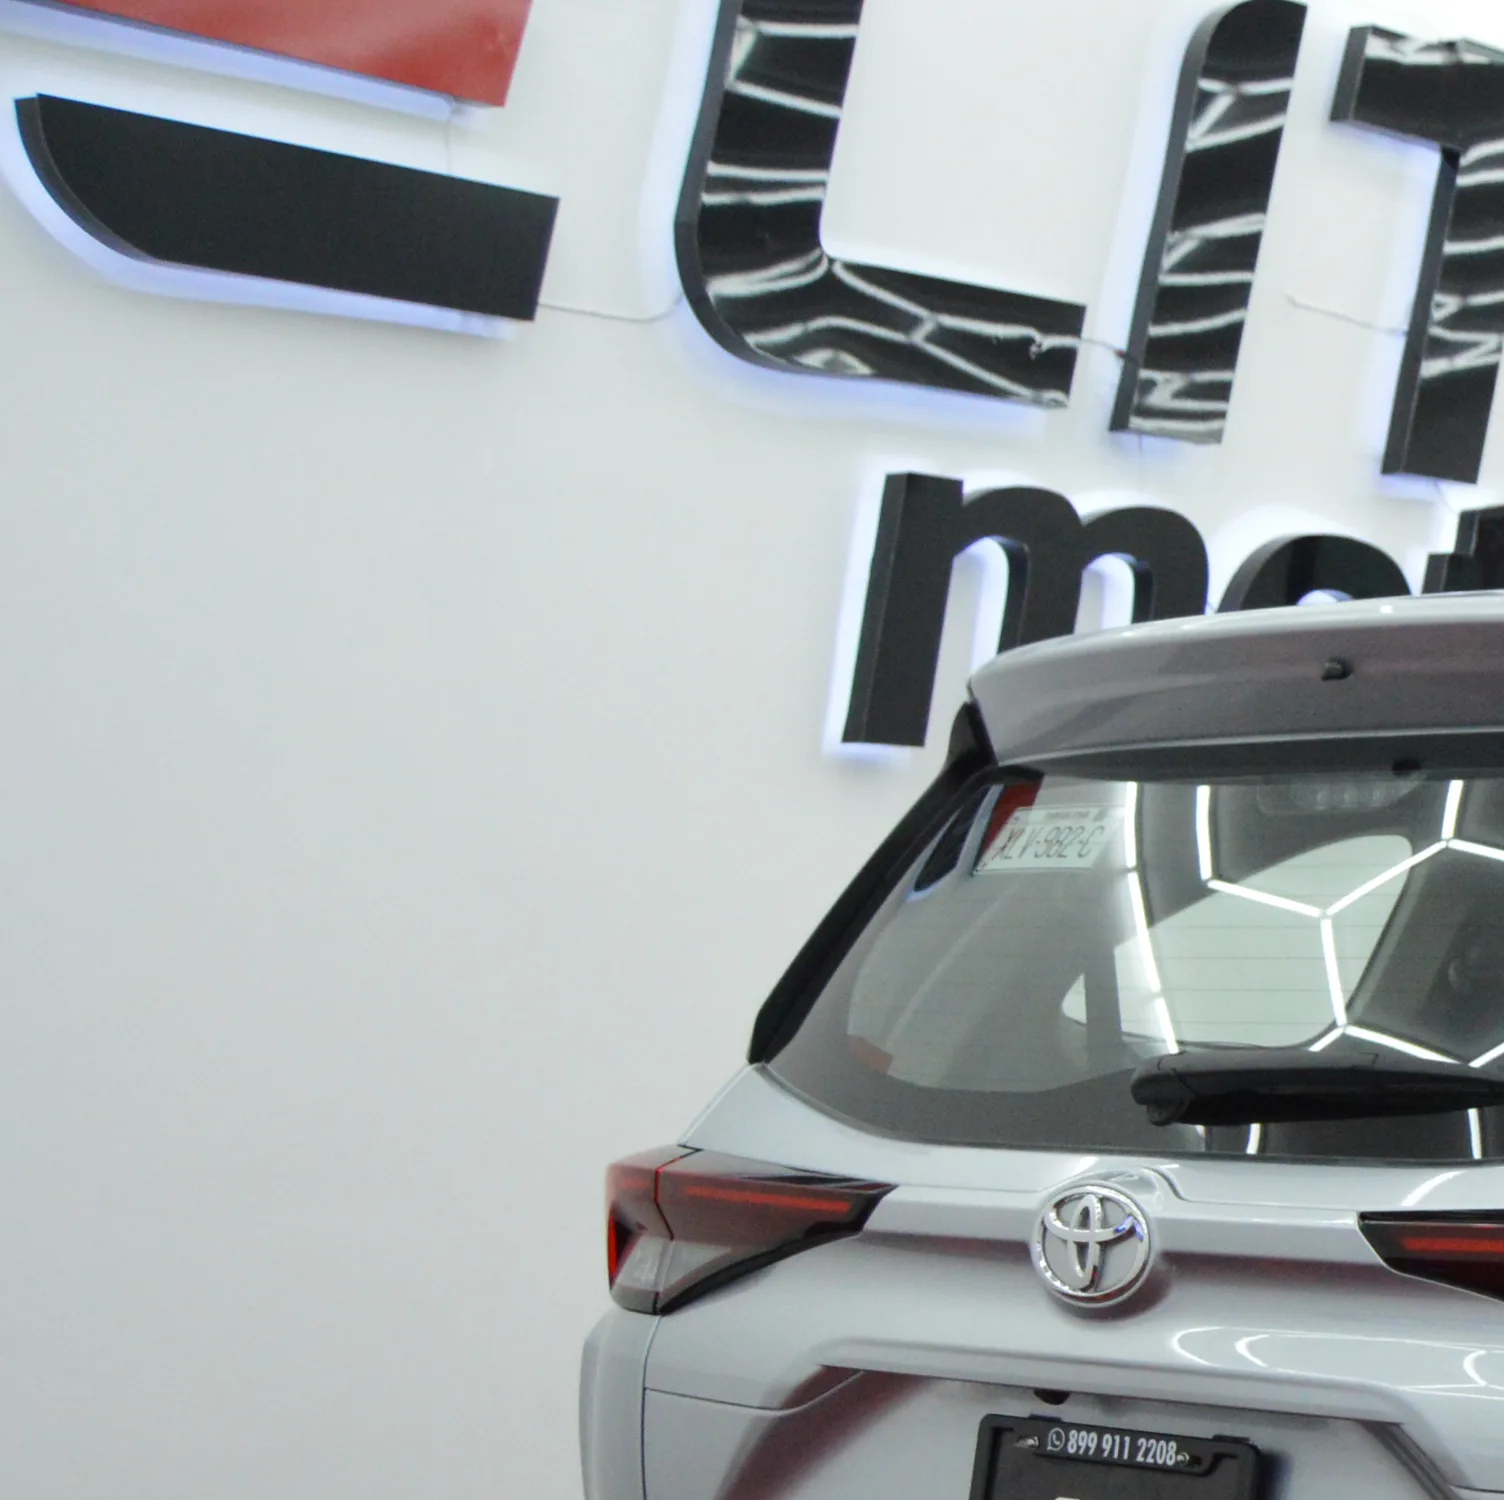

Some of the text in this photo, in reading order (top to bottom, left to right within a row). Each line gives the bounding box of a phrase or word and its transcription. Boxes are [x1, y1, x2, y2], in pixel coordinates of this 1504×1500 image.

[1067, 1429, 1177, 1465] 899 911 2208
